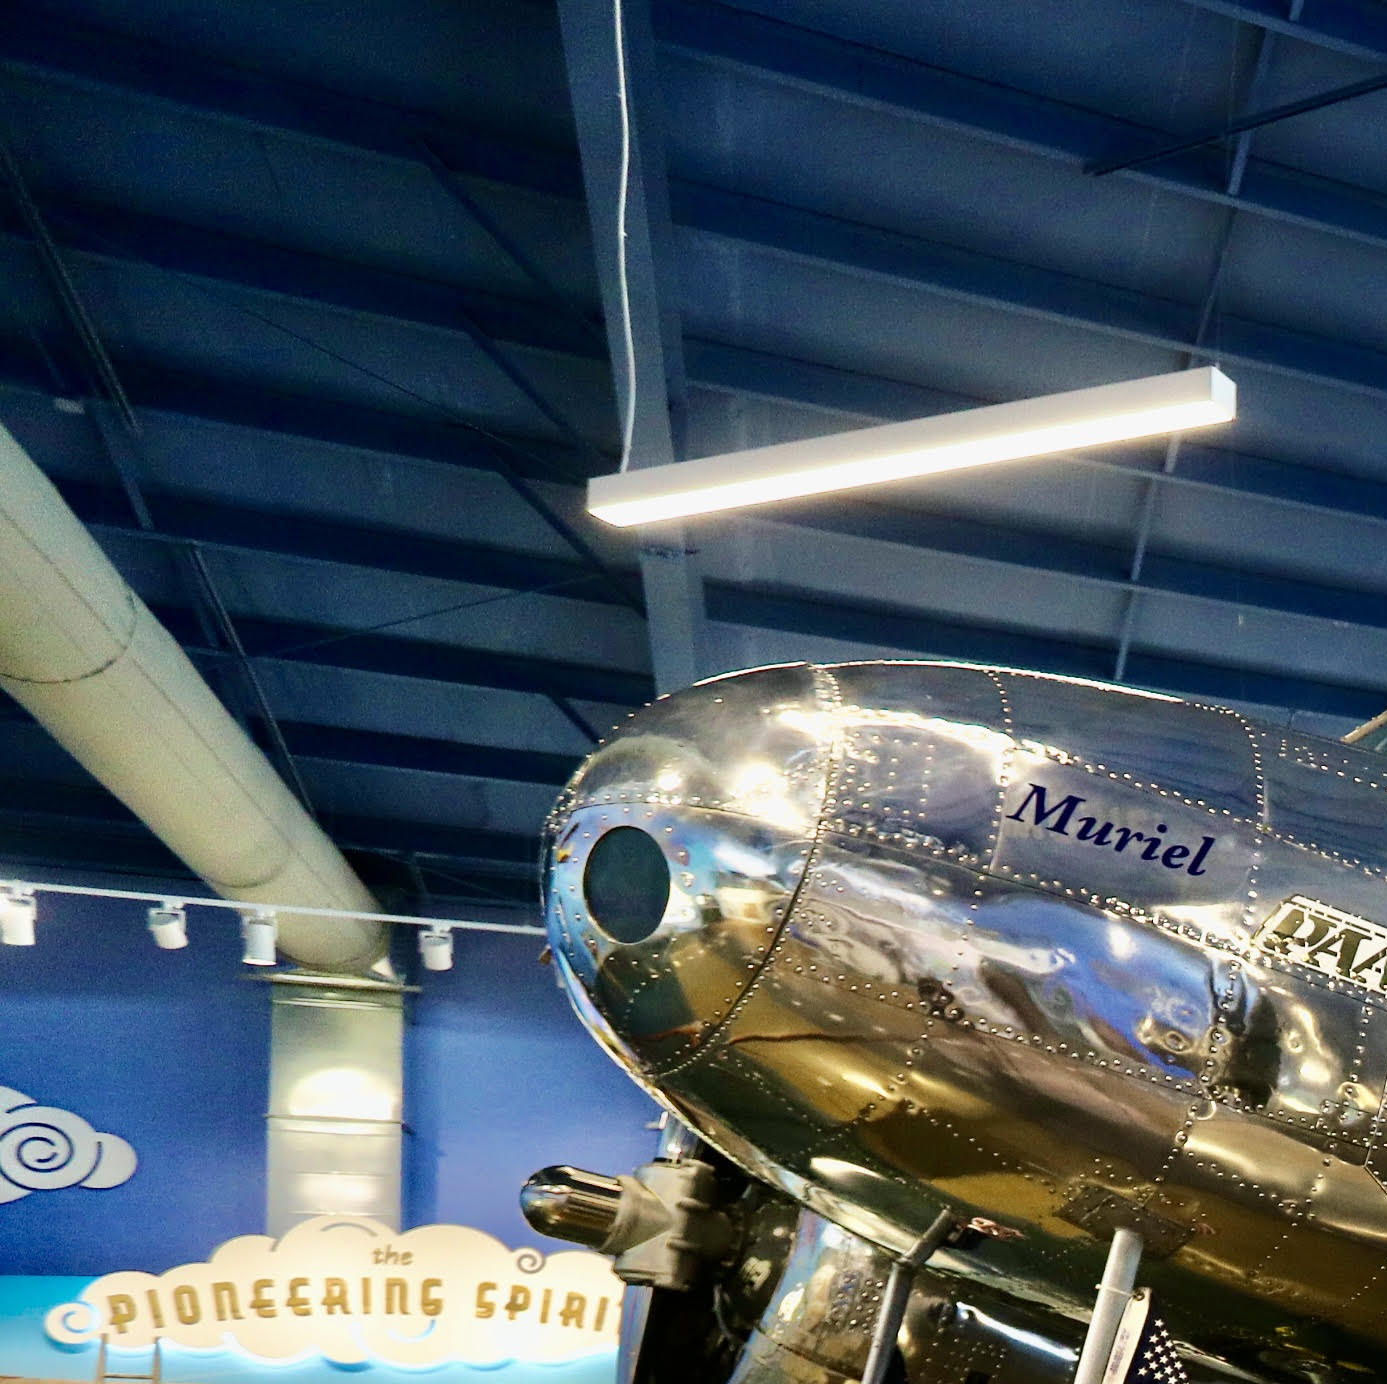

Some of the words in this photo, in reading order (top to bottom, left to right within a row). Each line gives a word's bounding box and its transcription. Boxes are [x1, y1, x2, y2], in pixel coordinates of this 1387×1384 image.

[1006, 783, 1215, 876] Muriel
[371, 1244, 414, 1266] the
[107, 1276, 444, 1334] PIONEERING
[474, 1281, 623, 1334] SPIRI
